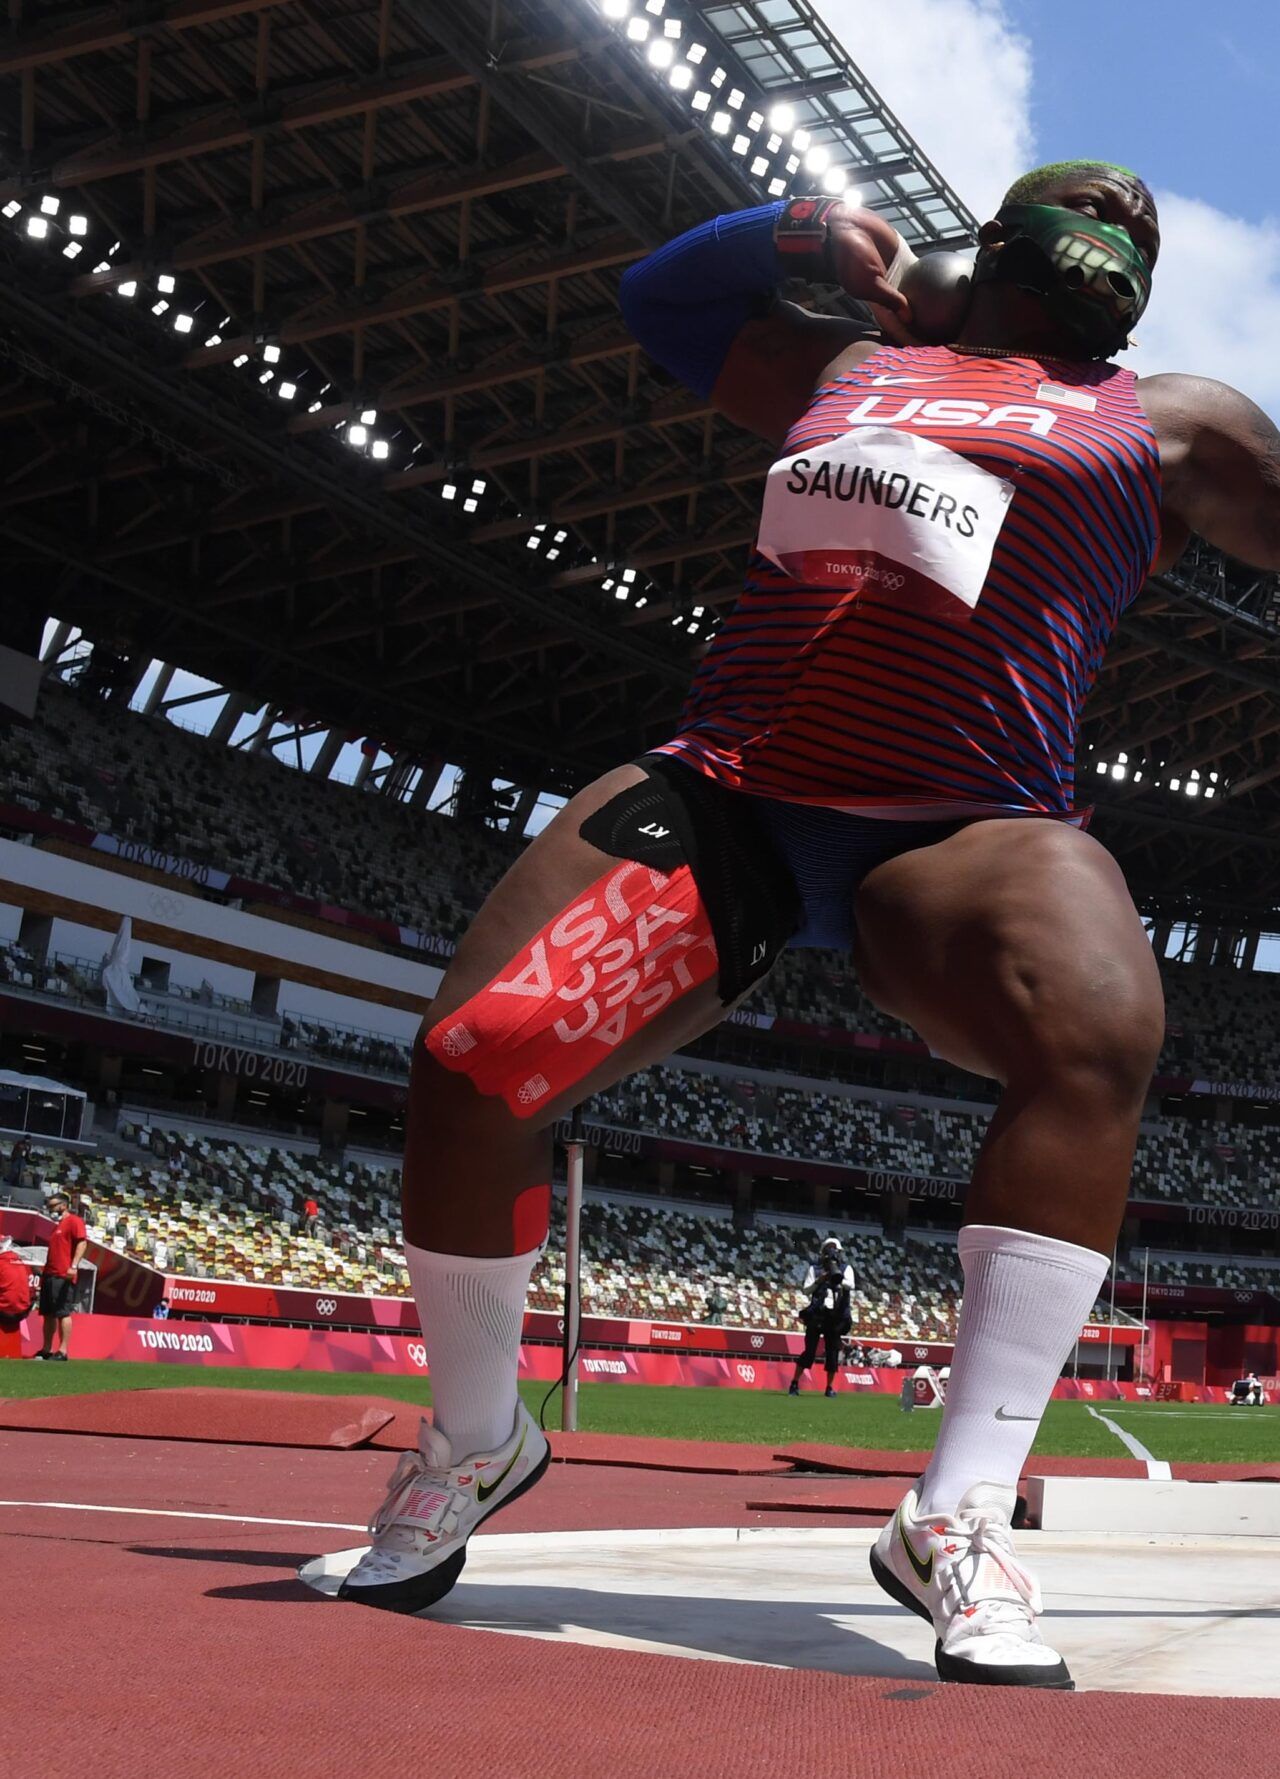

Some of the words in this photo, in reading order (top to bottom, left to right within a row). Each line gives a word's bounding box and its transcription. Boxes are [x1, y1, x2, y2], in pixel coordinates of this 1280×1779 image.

[846, 396, 1058, 435] USA
[787, 458, 979, 538] SAUNDERS
[826, 562, 862, 577] TOKYO
[116, 838, 168, 872] TOKYO
[170, 858, 209, 885] 2020
[489, 861, 669, 998] USA
[192, 1040, 257, 1077] TOKYO
[261, 1056, 308, 1088] 2020
[1208, 1081, 1249, 1098] TOKYO
[553, 1120, 601, 1147] TOYO
[604, 1130, 641, 1154] 2020
[865, 1171, 916, 1195] TOKYO
[920, 1179, 957, 1200] 2020
[1186, 1207, 1237, 1226] TOKYO
[1241, 1212, 1279, 1230] 2020
[168, 1286, 195, 1300] TOKYO
[195, 1288, 216, 1303] 2020
[137, 1330, 181, 1350] TOKYO
[180, 1334, 213, 1352] 2020
[582, 1359, 610, 1373] TOKYO
[608, 1360, 627, 1374] 2020
